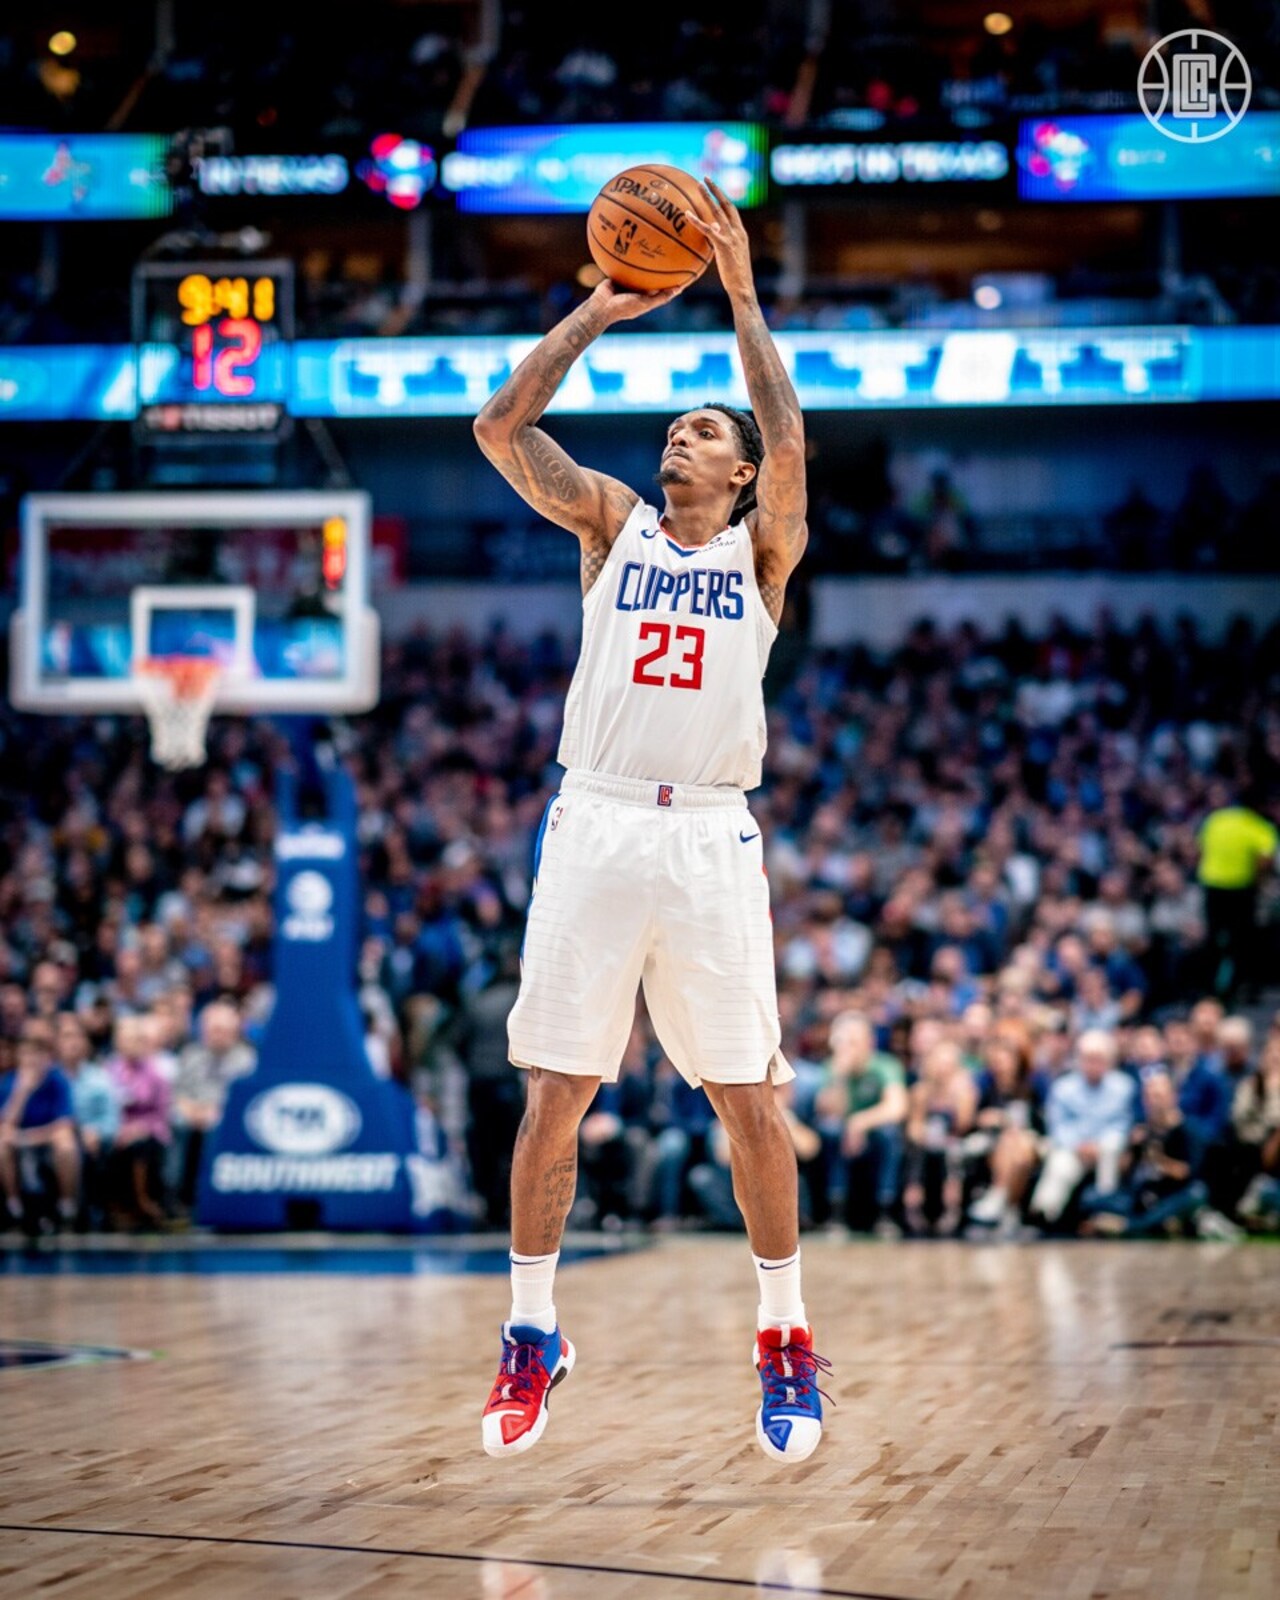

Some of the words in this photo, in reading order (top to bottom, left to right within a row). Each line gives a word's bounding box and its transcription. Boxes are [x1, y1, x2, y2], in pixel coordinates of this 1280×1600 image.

[610, 177, 686, 235] SPALDING
[192, 318, 262, 396] 12
[615, 561, 744, 620] CLIPPERS
[632, 622, 705, 690] 23
